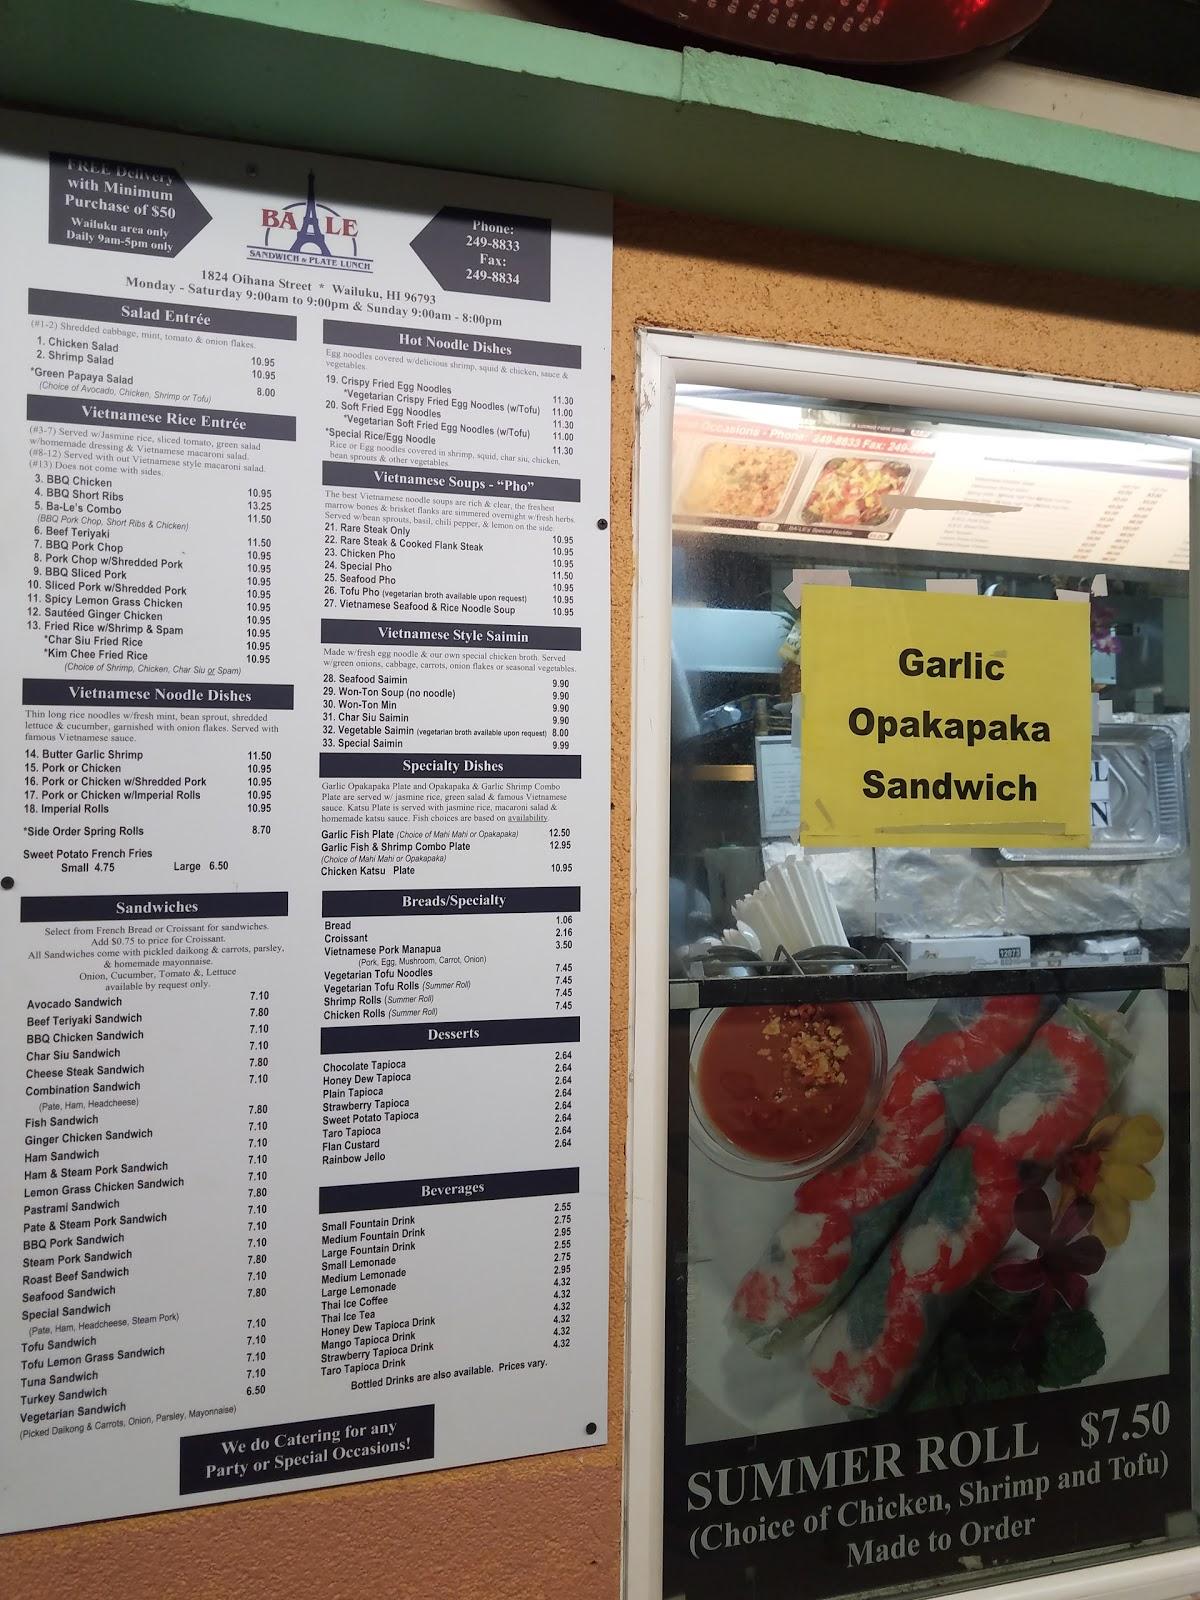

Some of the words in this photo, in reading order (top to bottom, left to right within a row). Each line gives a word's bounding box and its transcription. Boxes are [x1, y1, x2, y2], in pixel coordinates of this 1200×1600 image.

[67, 158, 111, 175] FREE
[116, 165, 174, 186] Delivery
[68, 178, 98, 191] with
[104, 181, 172, 201] Minimum
[66, 194, 130, 213] Purchase
[134, 204, 148, 215] of
[152, 206, 176, 219] $50
[71, 217, 117, 231] Wailuku
[120, 226, 143, 234] area
[146, 228, 168, 240] only
[262, 208, 298, 230] BA
[325, 216, 359, 237] LE
[472, 220, 514, 235] Phone:
[67, 230, 94, 244] Daily
[98, 234, 148, 249] 9am-5pm
[151, 242, 173, 253] only
[466, 235, 520, 252] 249-8833
[250, 250, 299, 262] SANDWICH
[309, 257, 338, 267] PLATE
[340, 261, 370, 270] LUNCH
[480, 253, 507, 267] Fax:
[465, 268, 520, 285] 249-8834
[202, 270, 228, 282] 1824
[232, 273, 274, 287] Oihana
[278, 279, 311, 291] Street
[332, 284, 383, 299] Wailuku,
[387, 290, 400, 301] HI
[404, 292, 436, 304] 96793
[126, 276, 176, 294] Monday
[188, 283, 242, 301] Saturday
[246, 290, 288, 303] 9:00am
[293, 296, 303, 305] to
[307, 296, 349, 311] 9:00pm
[352, 301, 362, 311] &
[367, 303, 408, 318] Sunday
[412, 308, 451, 321] 9:00am
[462, 313, 502, 327] 8:00pm
[122, 305, 160, 320] Salad
[166, 310, 210, 325] Entrée
[37, 336, 45, 345] 1.
[48, 337, 88, 349] Chicken
[92, 341, 118, 352] Salad
[400, 334, 422, 346] Hot
[426, 336, 469, 351] Noodle
[473, 341, 512, 355] Dishes
[252, 357, 275, 367] 10.95
[82, 405, 162, 423] Vietnamese
[167, 413, 196, 426] Rice
[202, 415, 246, 430] Entrée
[35, 473, 43, 483] 3.
[47, 474, 70, 486] BBQ
[72, 476, 112, 488] Chicken
[374, 471, 445, 486] Vietnamese
[449, 476, 485, 491] Soups
[248, 488, 272, 498] 10.95
[378, 627, 450, 640] Vietnamese
[453, 630, 483, 643] Style
[486, 630, 528, 642] Saimin
[899, 648, 1004, 681] Garlic
[323, 673, 336, 683] 28.
[339, 674, 375, 684] Seafood
[378, 675, 408, 684] Saimin
[552, 679, 569, 688] 9.90
[69, 686, 150, 699] Vietnamese
[155, 688, 203, 701] Noodle
[208, 690, 251, 702] Dishes
[848, 707, 1050, 747] Opakapaka
[25, 749, 39, 758] 14.
[42, 749, 73, 759] Butter
[76, 749, 105, 759] Garlic
[108, 749, 143, 761] Shrimp
[248, 751, 272, 760] 11.50
[403, 760, 460, 774] Specialty
[464, 760, 503, 771] Dishes
[862, 770, 1036, 801] Sandwich
[61, 863, 88, 872] Small
[94, 862, 115, 872] 4.75
[174, 862, 201, 873] Large
[209, 860, 228, 870] 6.50
[116, 901, 198, 914] Sandwiches
[403, 894, 506, 909] Breads/Specialty
[325, 921, 351, 930] Bread
[556, 915, 572, 924] 1.06
[45, 927, 70, 936] Select
[74, 927, 94, 935] from
[96, 926, 125, 934] French
[128, 925, 152, 933] Bread
[207, 923, 219, 932] for
[221, 922, 269, 931] sandwiches.
[27, 999, 72, 1009] Avocado
[74, 996, 122, 1007] Sandwich
[250, 991, 269, 1000] 7.10
[428, 1028, 480, 1040] Desserts
[555, 1051, 572, 1060] 2.64
[323, 1062, 368, 1072] Chocolate
[371, 1060, 406, 1071] Tapioca
[422, 1184, 484, 1197] Beverages
[554, 1202, 571, 1212] 2.55
[322, 1221, 347, 1232] Small
[350, 1218, 389, 1229] Fountain
[392, 1216, 415, 1226] Drink
[351, 1378, 383, 1390] Bottled
[386, 1374, 414, 1386] Drinks
[417, 1373, 430, 1382] are
[433, 1370, 452, 1380] also
[454, 1365, 494, 1377] available.
[499, 1362, 525, 1371] Prices
[527, 1360, 547, 1369] vary.
[20, 1394, 56, 1405] Turkey
[58, 1387, 107, 1401] Sandwich
[246, 1385, 266, 1396] 6.50
[20, 1427, 50, 1440] (Picked
[52, 1425, 84, 1435] Daikong
[94, 1420, 126, 1430] Carrots,
[128, 1417, 154, 1426] Onion,
[156, 1412, 186, 1422] Parsley,
[188, 1404, 236, 1419] Mayonnaise)
[1081, 1401, 1170, 1449] $7.50
[222, 1441, 246, 1454] We
[251, 1438, 270, 1451] do
[274, 1429, 340, 1447] Catering
[345, 1425, 367, 1438] for
[371, 1423, 396, 1436] any
[206, 1462, 248, 1478] Party
[253, 1460, 270, 1471] or
[274, 1449, 328, 1471] Special
[332, 1437, 410, 1460] Occasions!
[688, 1443, 904, 1512] SUMMER
[918, 1423, 1039, 1473] ROLL
[690, 1516, 794, 1559] (Choice
[804, 1505, 832, 1533] of
[838, 1493, 951, 1527] Chicken,
[960, 1475, 1050, 1507] Shrimp
[1058, 1461, 1100, 1489] and
[1108, 1450, 1168, 1480] Tofu)
[848, 1534, 920, 1567] Made
[928, 1531, 952, 1552] to
[960, 1516, 1035, 1546] Order
